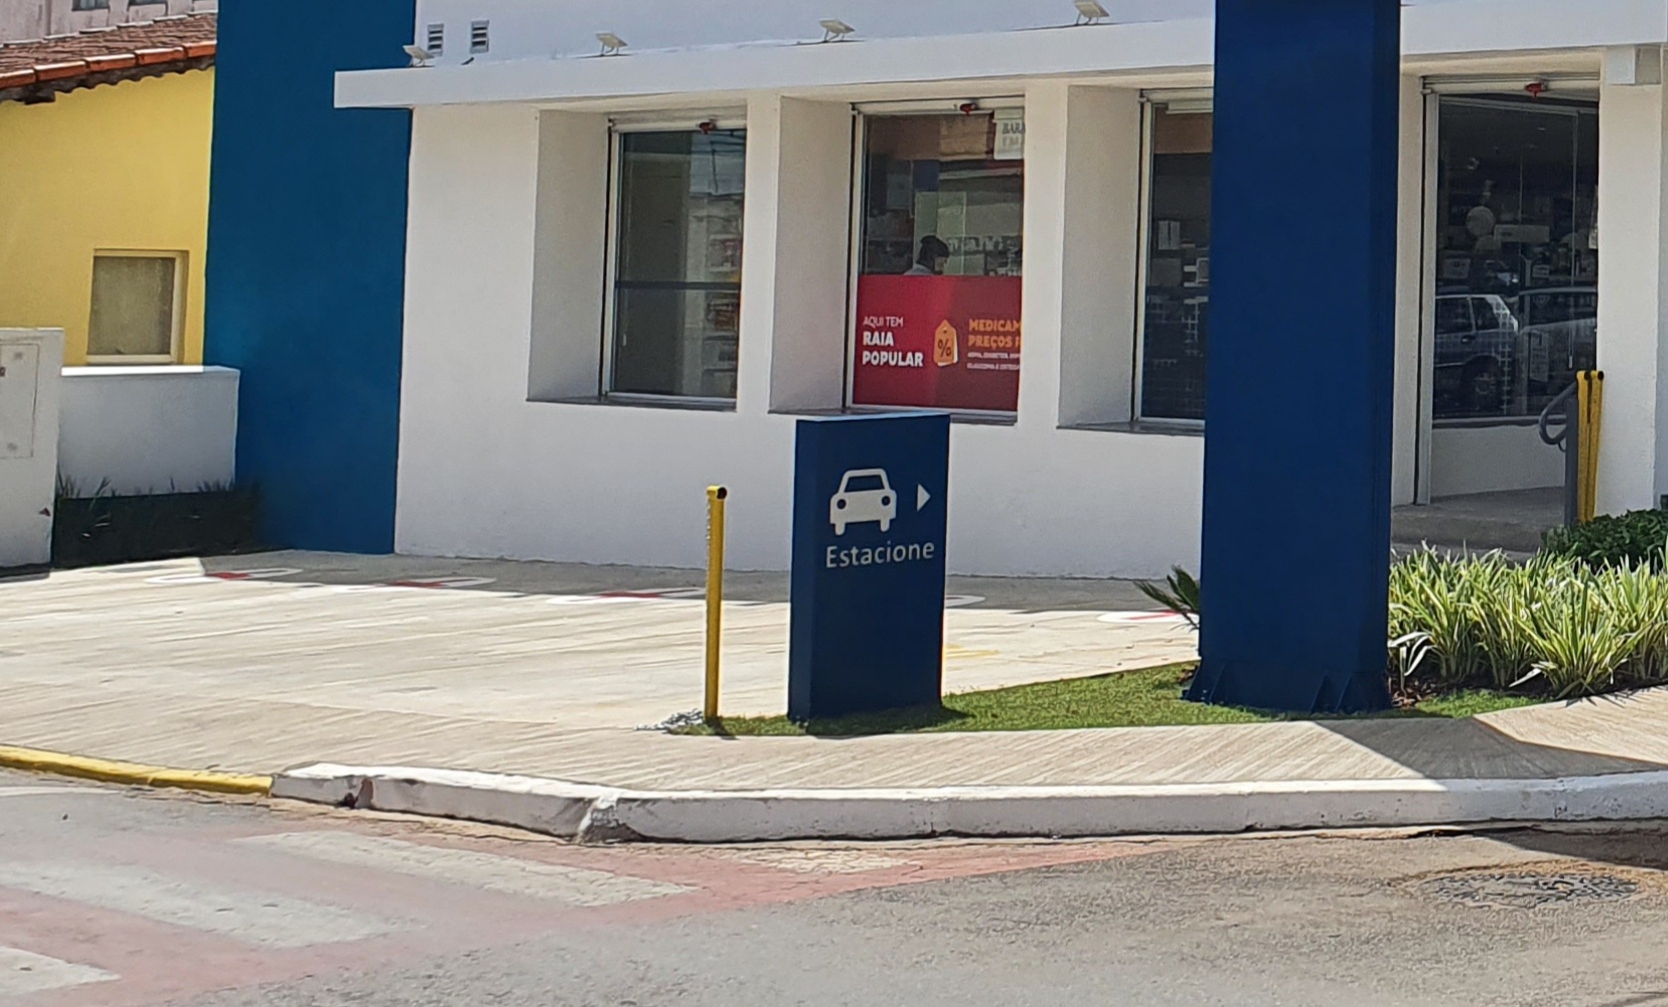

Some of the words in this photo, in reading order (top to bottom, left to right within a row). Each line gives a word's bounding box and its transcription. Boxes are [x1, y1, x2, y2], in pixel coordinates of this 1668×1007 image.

[862, 315, 884, 329] AQUI
[885, 315, 904, 328] TEM
[862, 331, 895, 347] RAIA
[967, 333, 1013, 350] PREÇOS
[861, 350, 924, 368] POPULAR
[825, 540, 935, 569] Estacione
